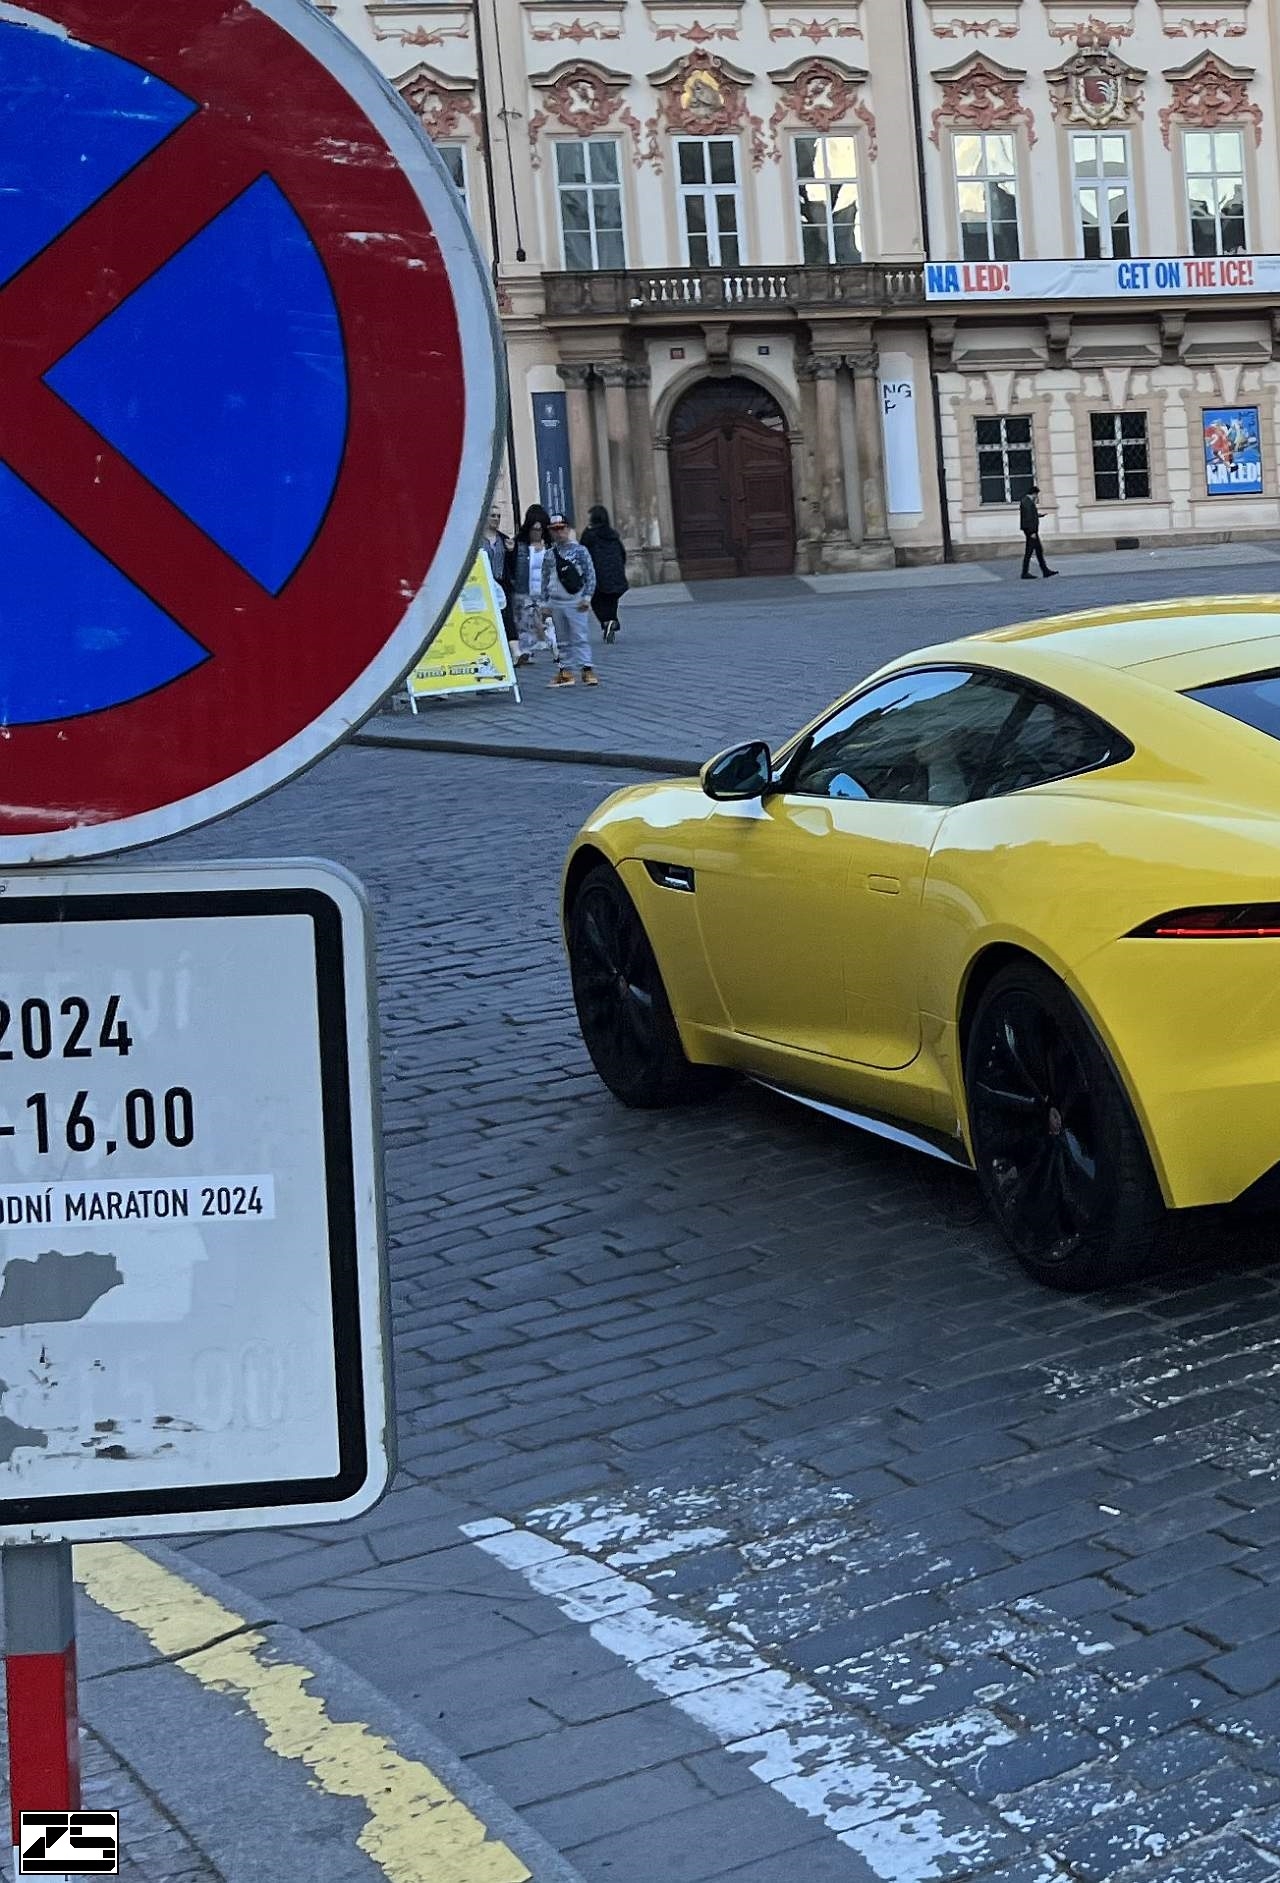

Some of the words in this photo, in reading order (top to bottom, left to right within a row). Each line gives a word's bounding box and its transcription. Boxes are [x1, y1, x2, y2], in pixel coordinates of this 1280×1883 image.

[928, 264, 959, 293] NA
[962, 263, 1011, 293] LED!
[1118, 262, 1153, 290] GET
[1155, 261, 1181, 289] ON
[1184, 260, 1217, 288] THE
[1219, 259, 1254, 287] ICE!
[64, 1188, 189, 1222] MARATON
[201, 1185, 264, 1216] 2024
